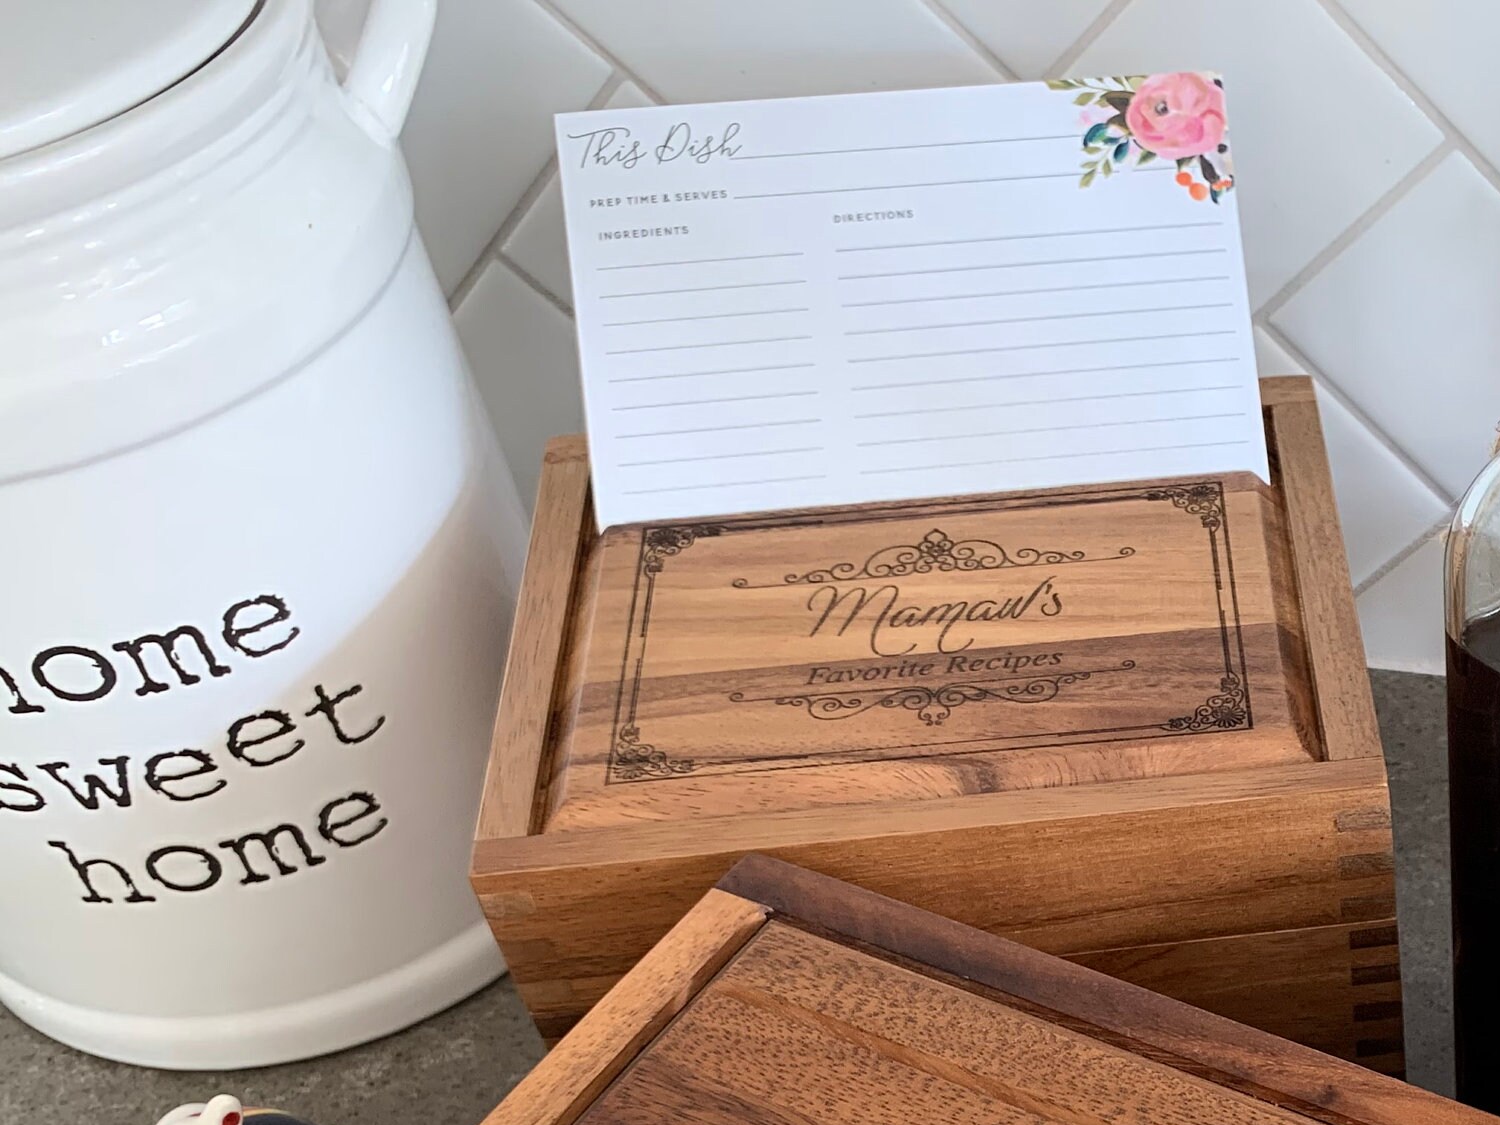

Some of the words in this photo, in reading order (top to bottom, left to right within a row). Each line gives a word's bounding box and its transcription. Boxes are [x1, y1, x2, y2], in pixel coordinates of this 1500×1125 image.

[567, 127, 647, 169] This
[655, 122, 743, 165] Dish
[590, 197, 622, 208] PREP
[627, 194, 657, 206] TIME
[662, 194, 671, 203] &
[675, 190, 728, 202] SERVES
[833, 209, 914, 223] DIRECTIONS
[598, 225, 690, 241] INGREDIENTS
[808, 575, 1063, 657] Mamaw's
[0, 594, 300, 713] ome
[804, 657, 935, 687] Favorite
[949, 647, 1064, 675] Recipes
[47, 791, 389, 904] home
